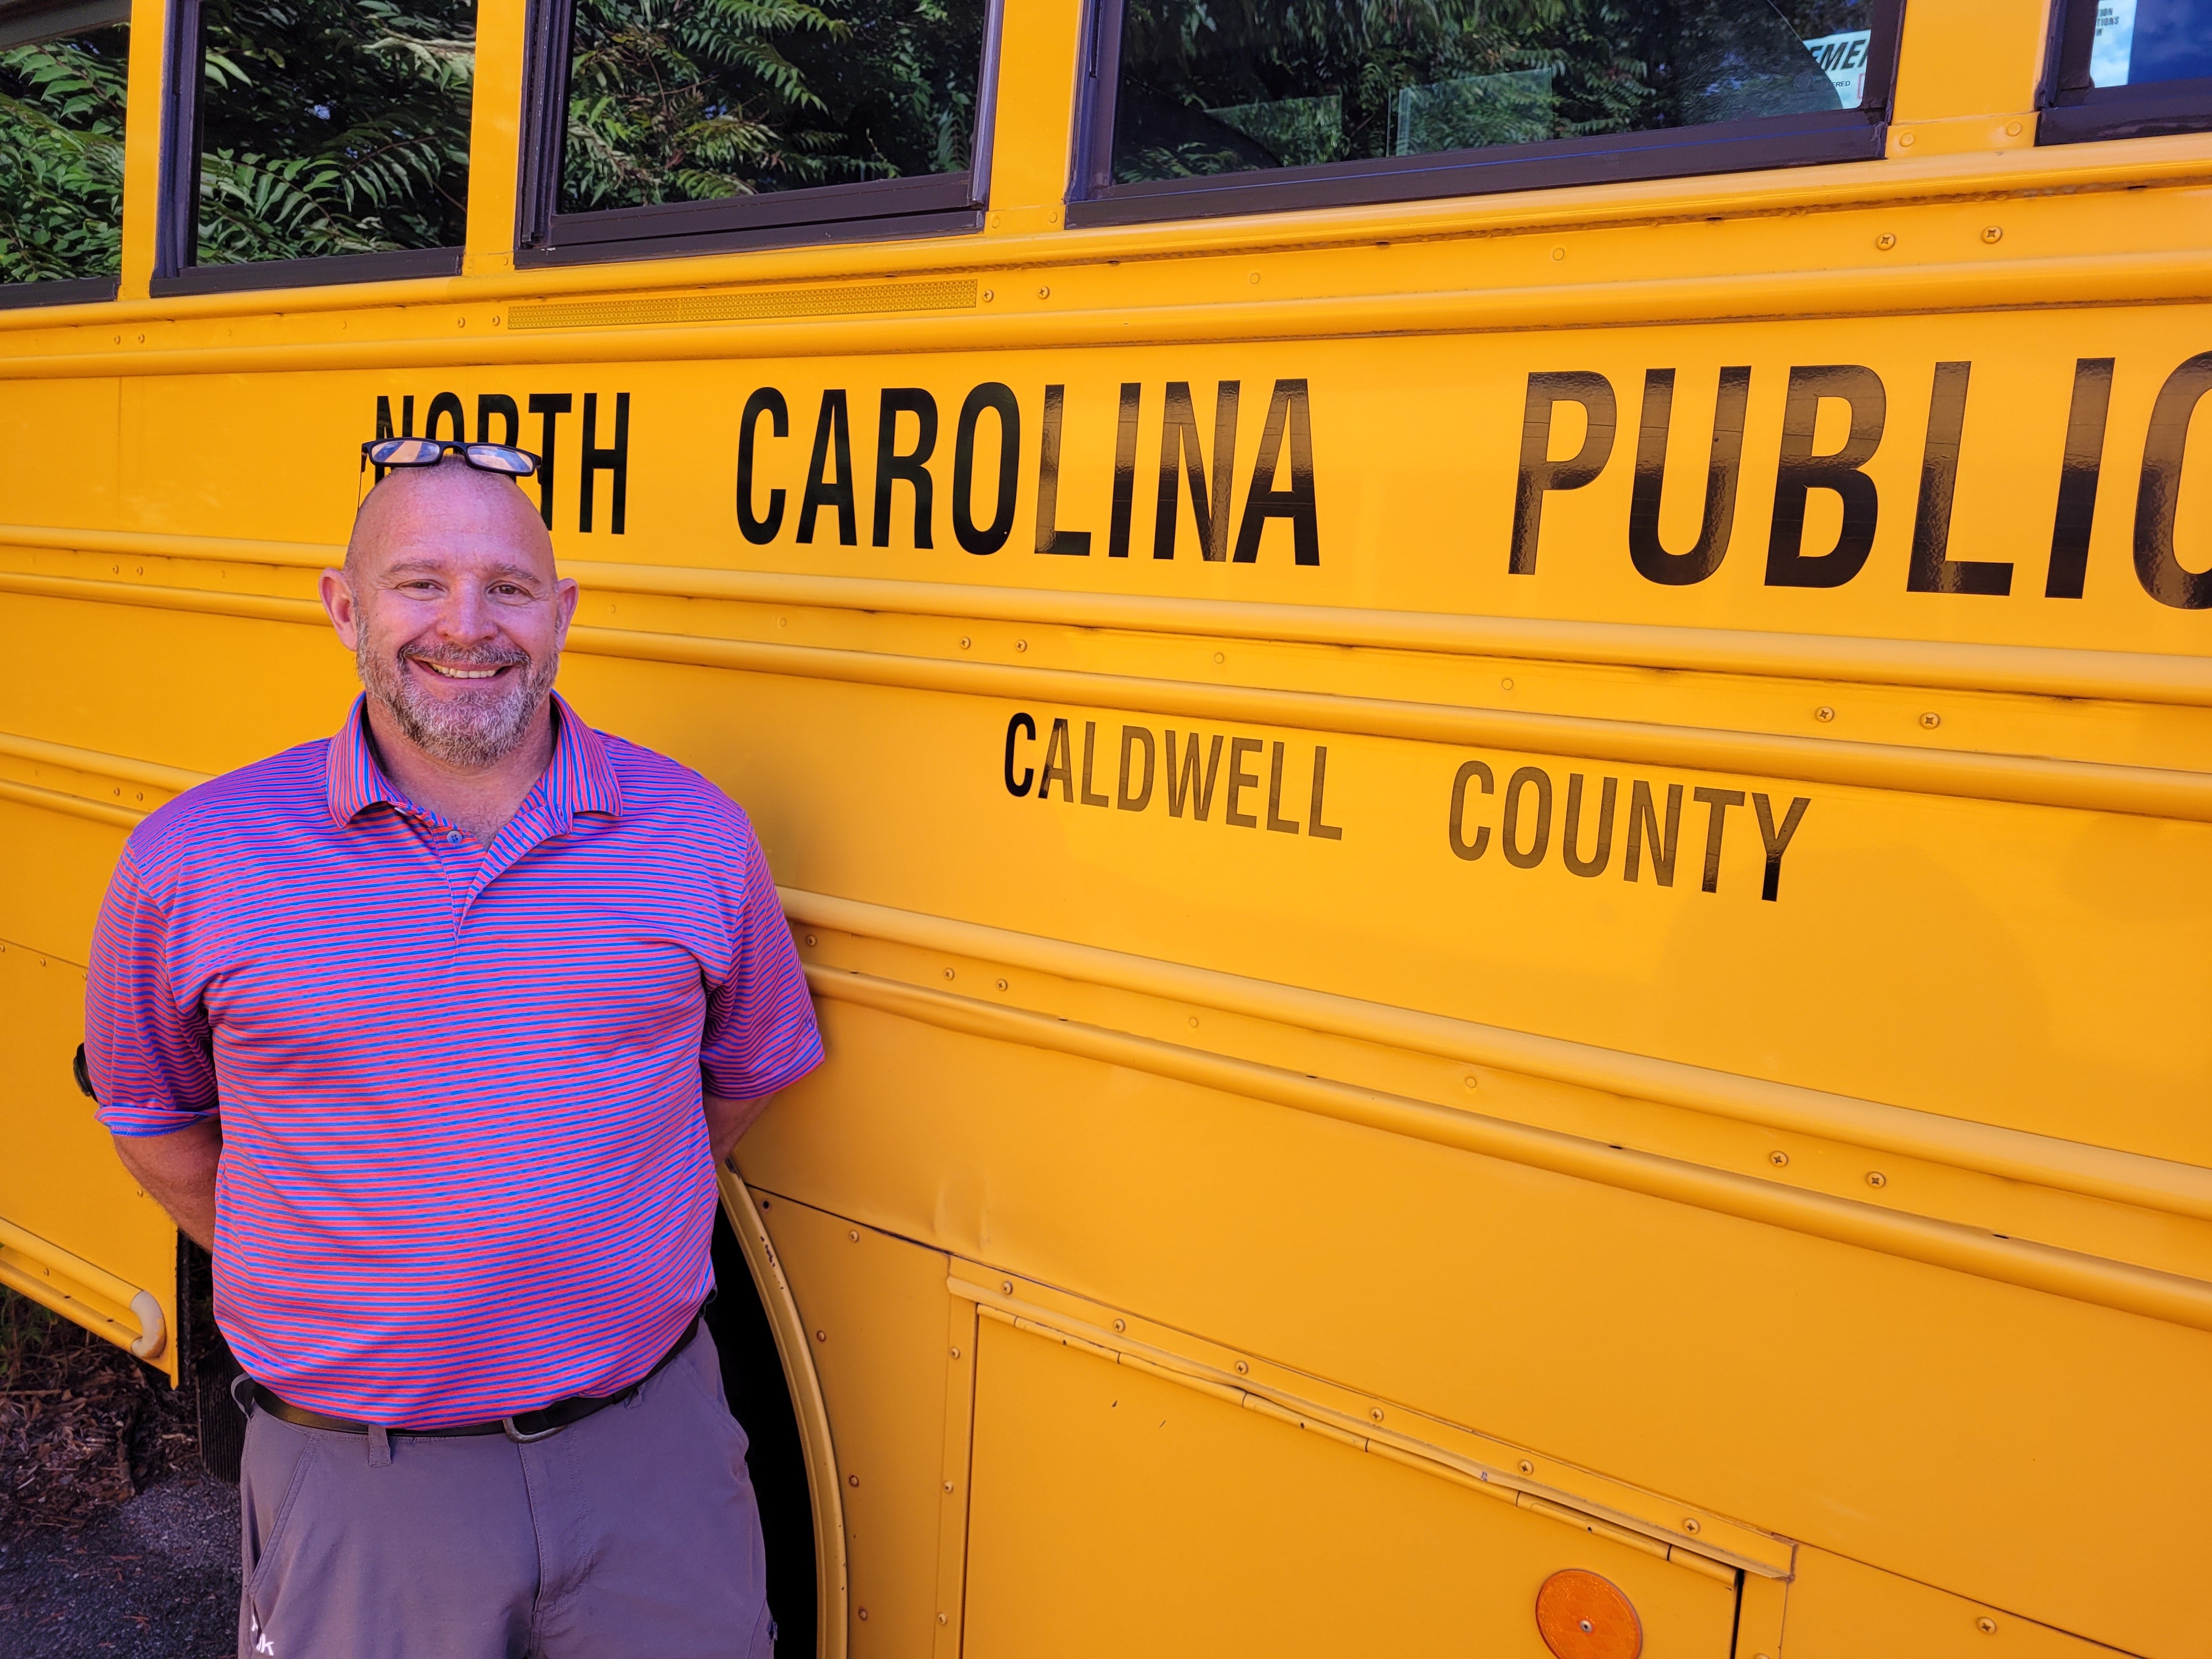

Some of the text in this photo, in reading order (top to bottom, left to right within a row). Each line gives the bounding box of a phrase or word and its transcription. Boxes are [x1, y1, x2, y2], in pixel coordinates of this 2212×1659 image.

[736, 378, 1321, 566] CAROLINA
[1508, 351, 2212, 610] PUBLIC
[1004, 712, 1812, 902] CALDWELL COUNTY
